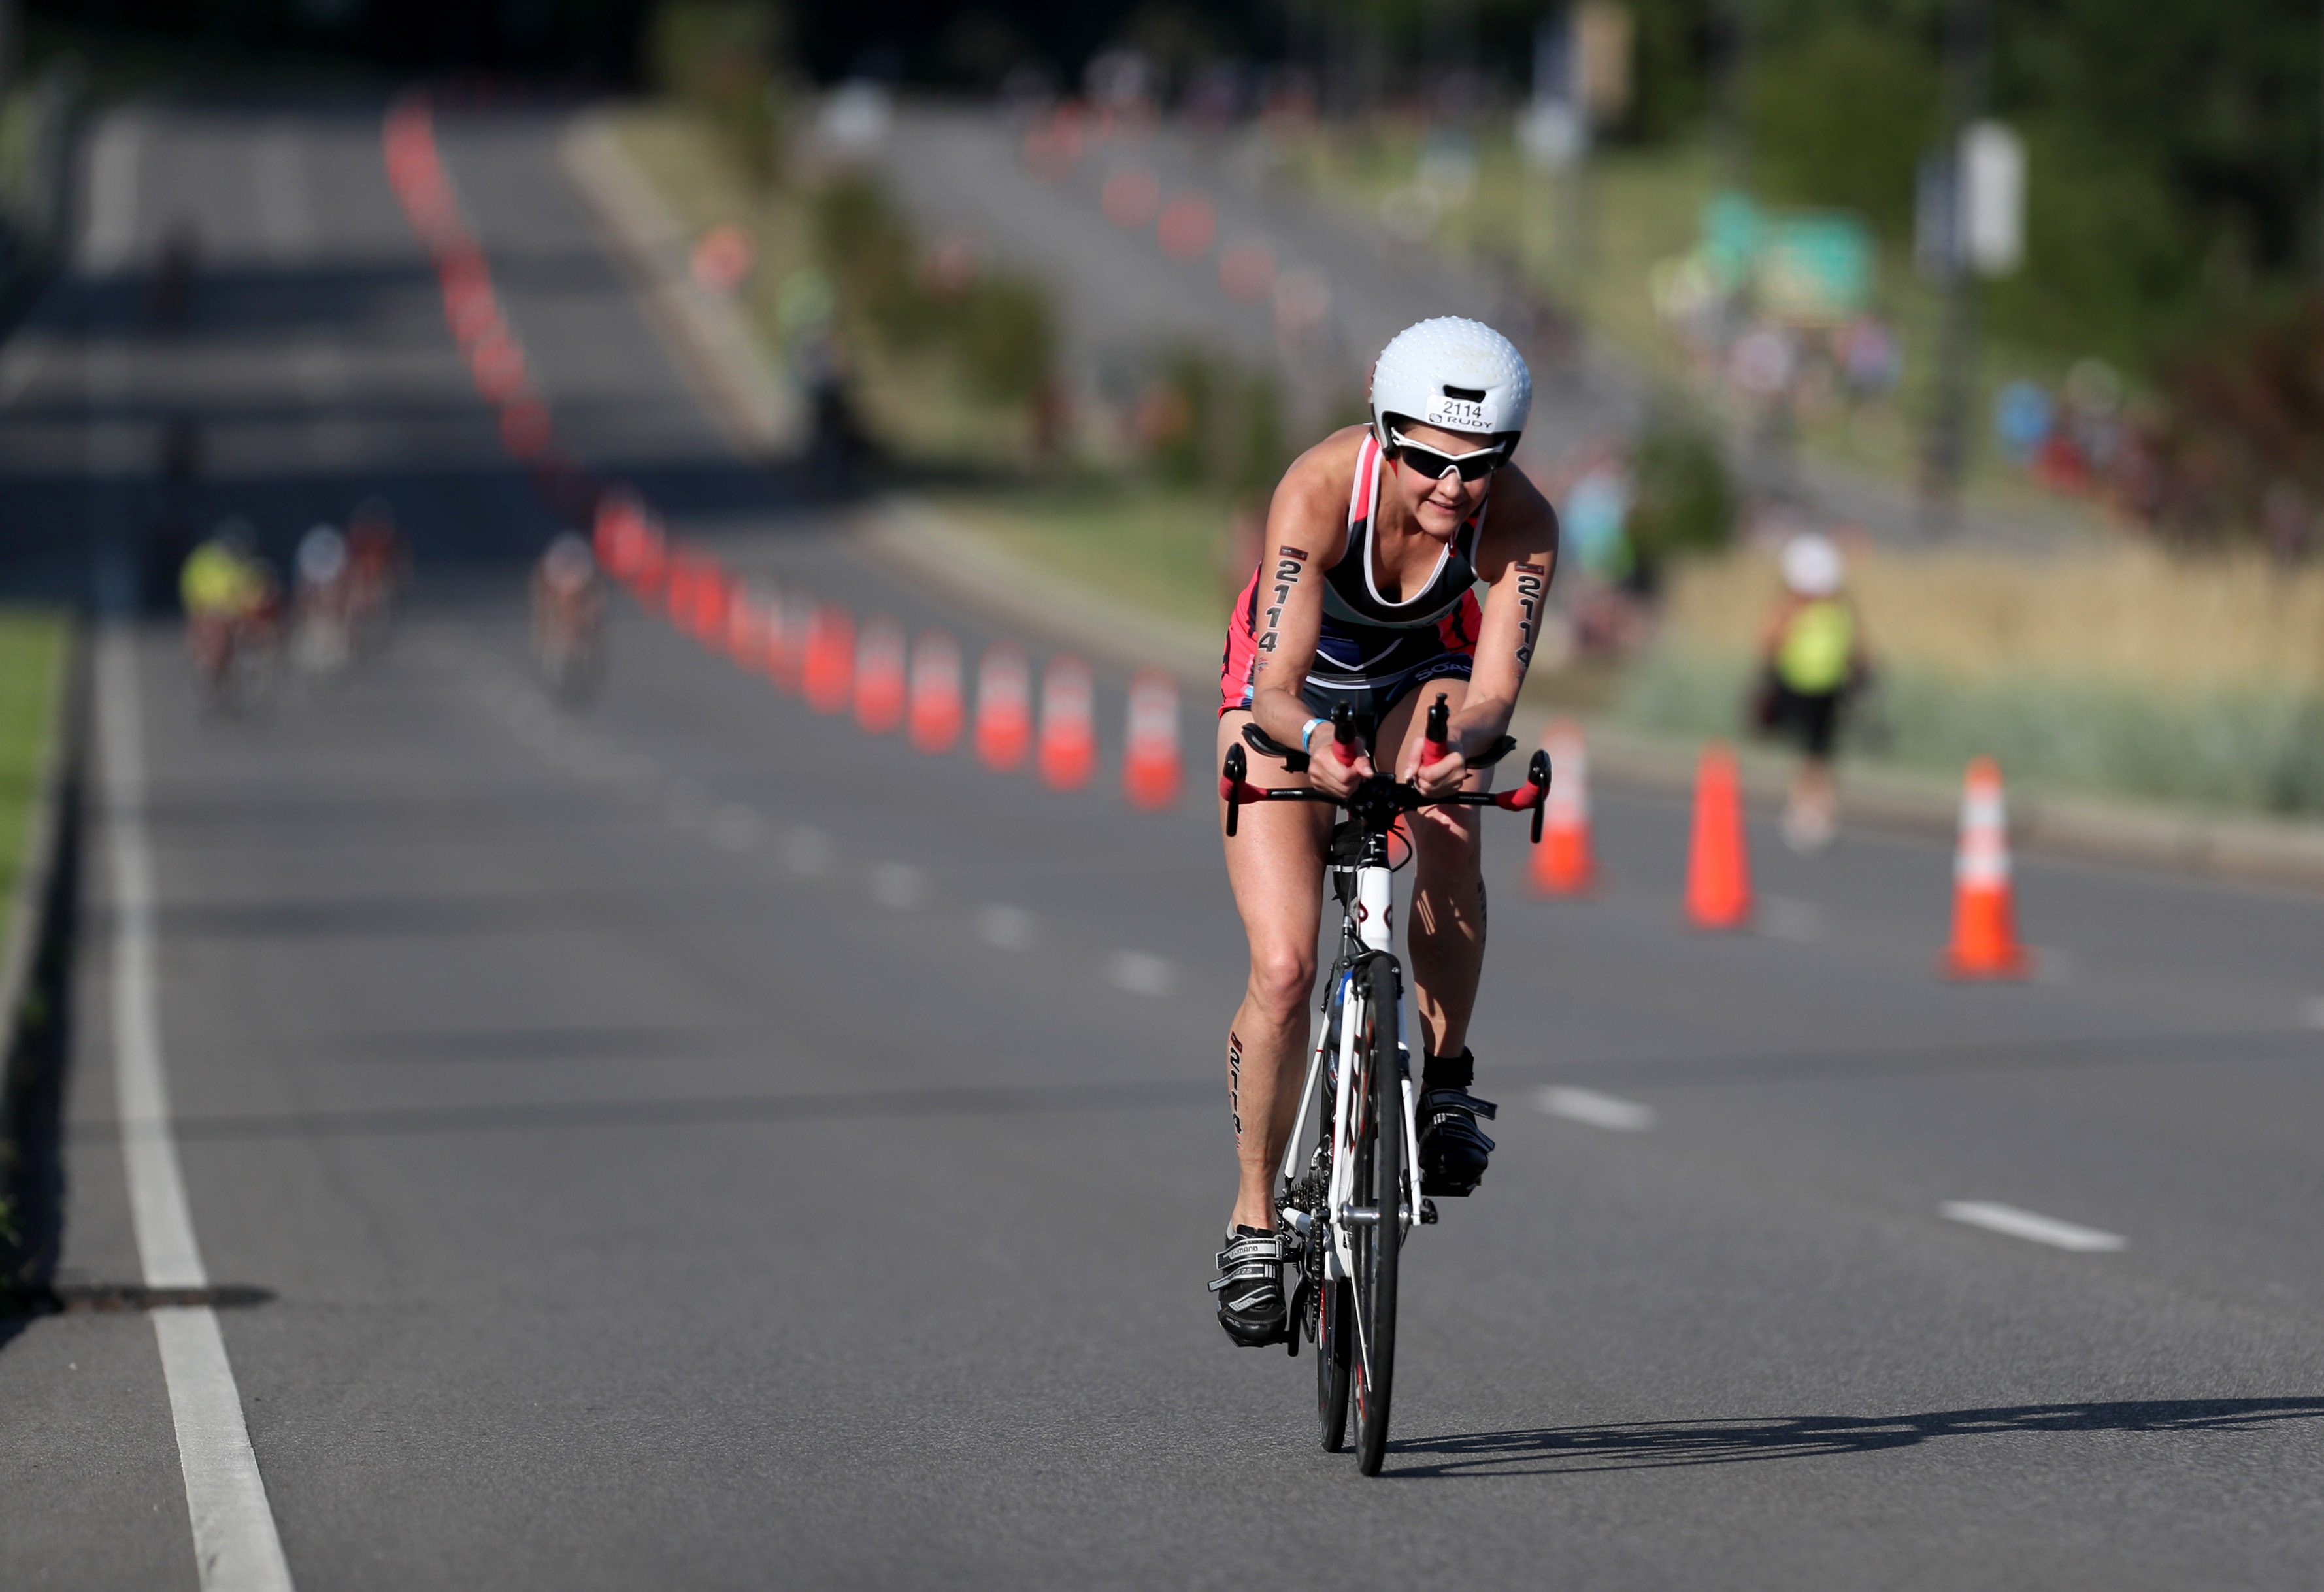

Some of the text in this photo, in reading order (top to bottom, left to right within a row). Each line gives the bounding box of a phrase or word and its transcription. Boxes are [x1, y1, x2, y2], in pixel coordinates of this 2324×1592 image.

[1442, 401, 1481, 418] 2114
[1447, 416, 1493, 428] RUDY
[1257, 559, 1302, 653] 2114
[1231, 1246, 1259, 1257] SHIMANO
